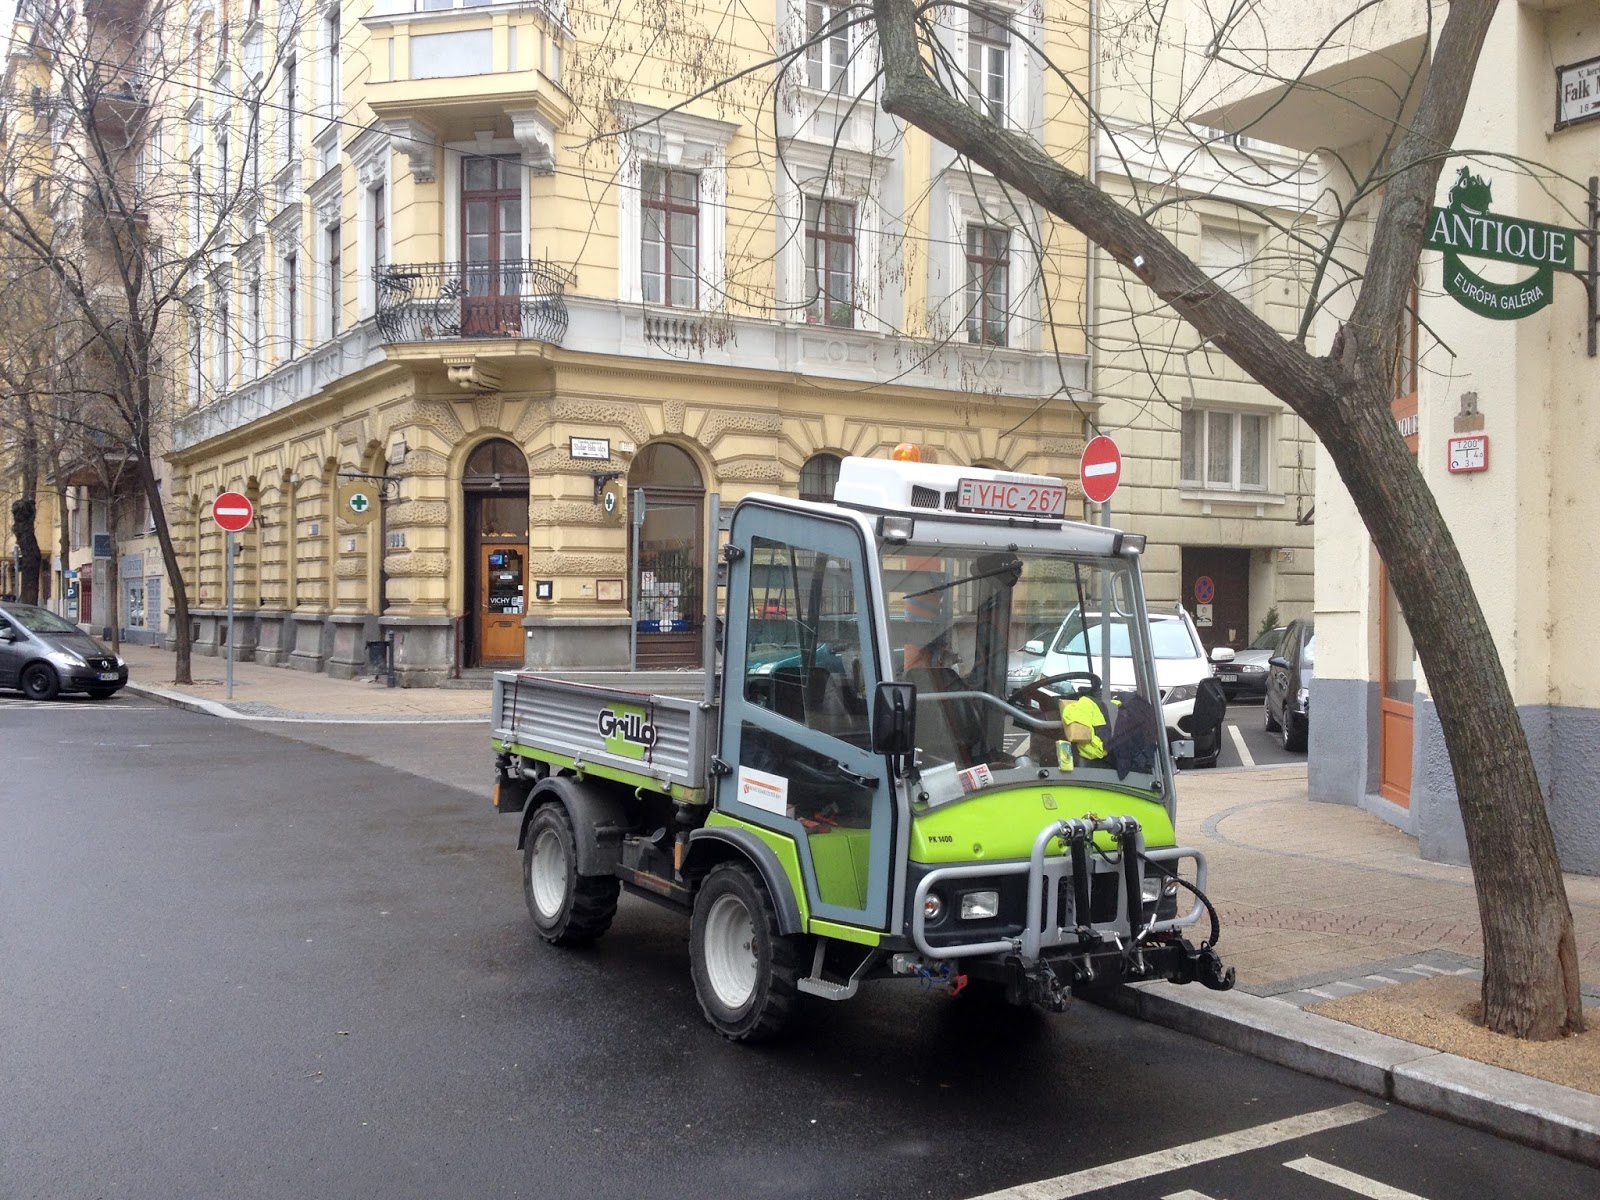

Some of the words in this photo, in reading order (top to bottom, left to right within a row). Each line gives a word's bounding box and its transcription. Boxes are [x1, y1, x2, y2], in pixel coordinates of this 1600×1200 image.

[1565, 79, 1591, 103] Falk
[1430, 210, 1567, 264] ANTIQUE
[1453, 272, 1498, 308] EURÓPA
[1500, 285, 1544, 310] GALÉRIA
[962, 495, 971, 506] H
[978, 484, 1063, 512] YHC-267
[68, 588, 75, 597] P
[598, 708, 656, 747] Grillo
[928, 835, 937, 843] PK
[938, 835, 953, 843] 1400
